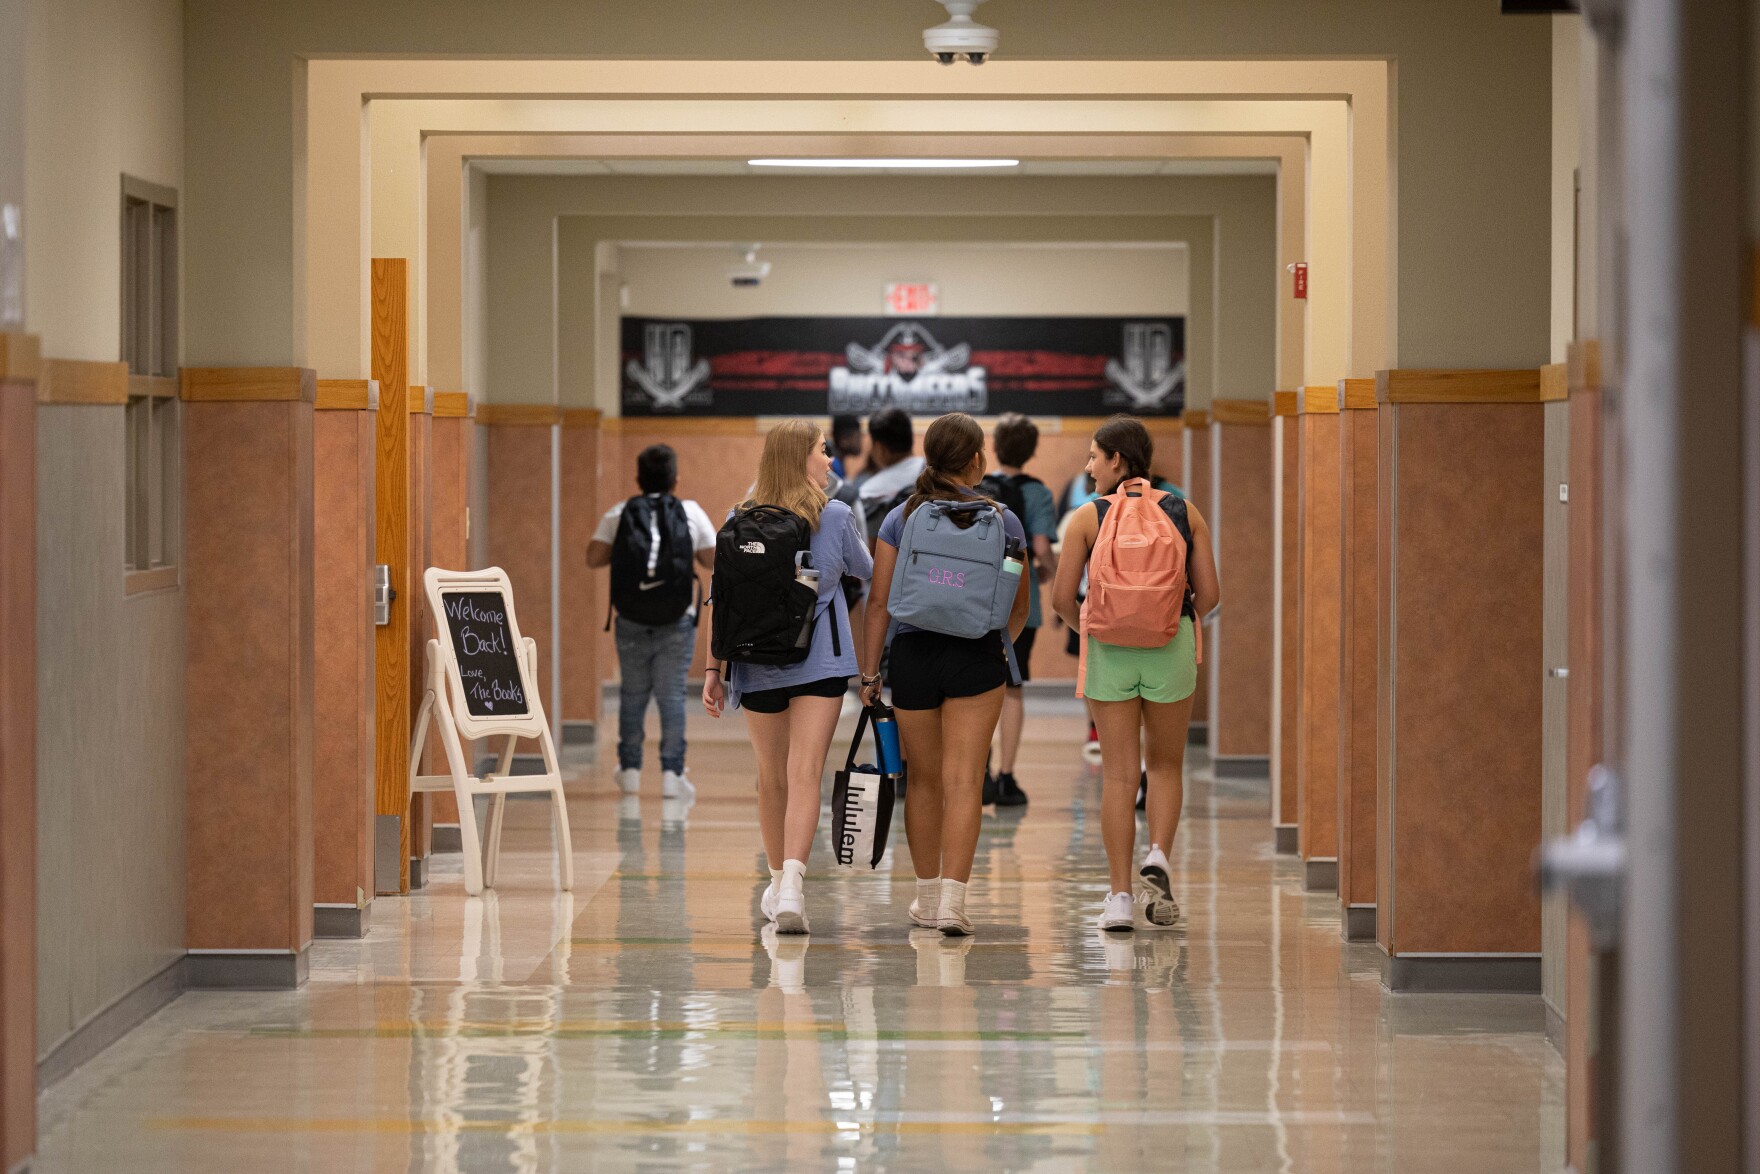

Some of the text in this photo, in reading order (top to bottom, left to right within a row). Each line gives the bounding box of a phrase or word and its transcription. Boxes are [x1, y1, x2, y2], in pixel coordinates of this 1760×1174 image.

[444, 597, 503, 625] Welcome
[461, 626, 508, 656] Back!
[461, 665, 486, 682] Love,
[470, 682, 491, 700] The
